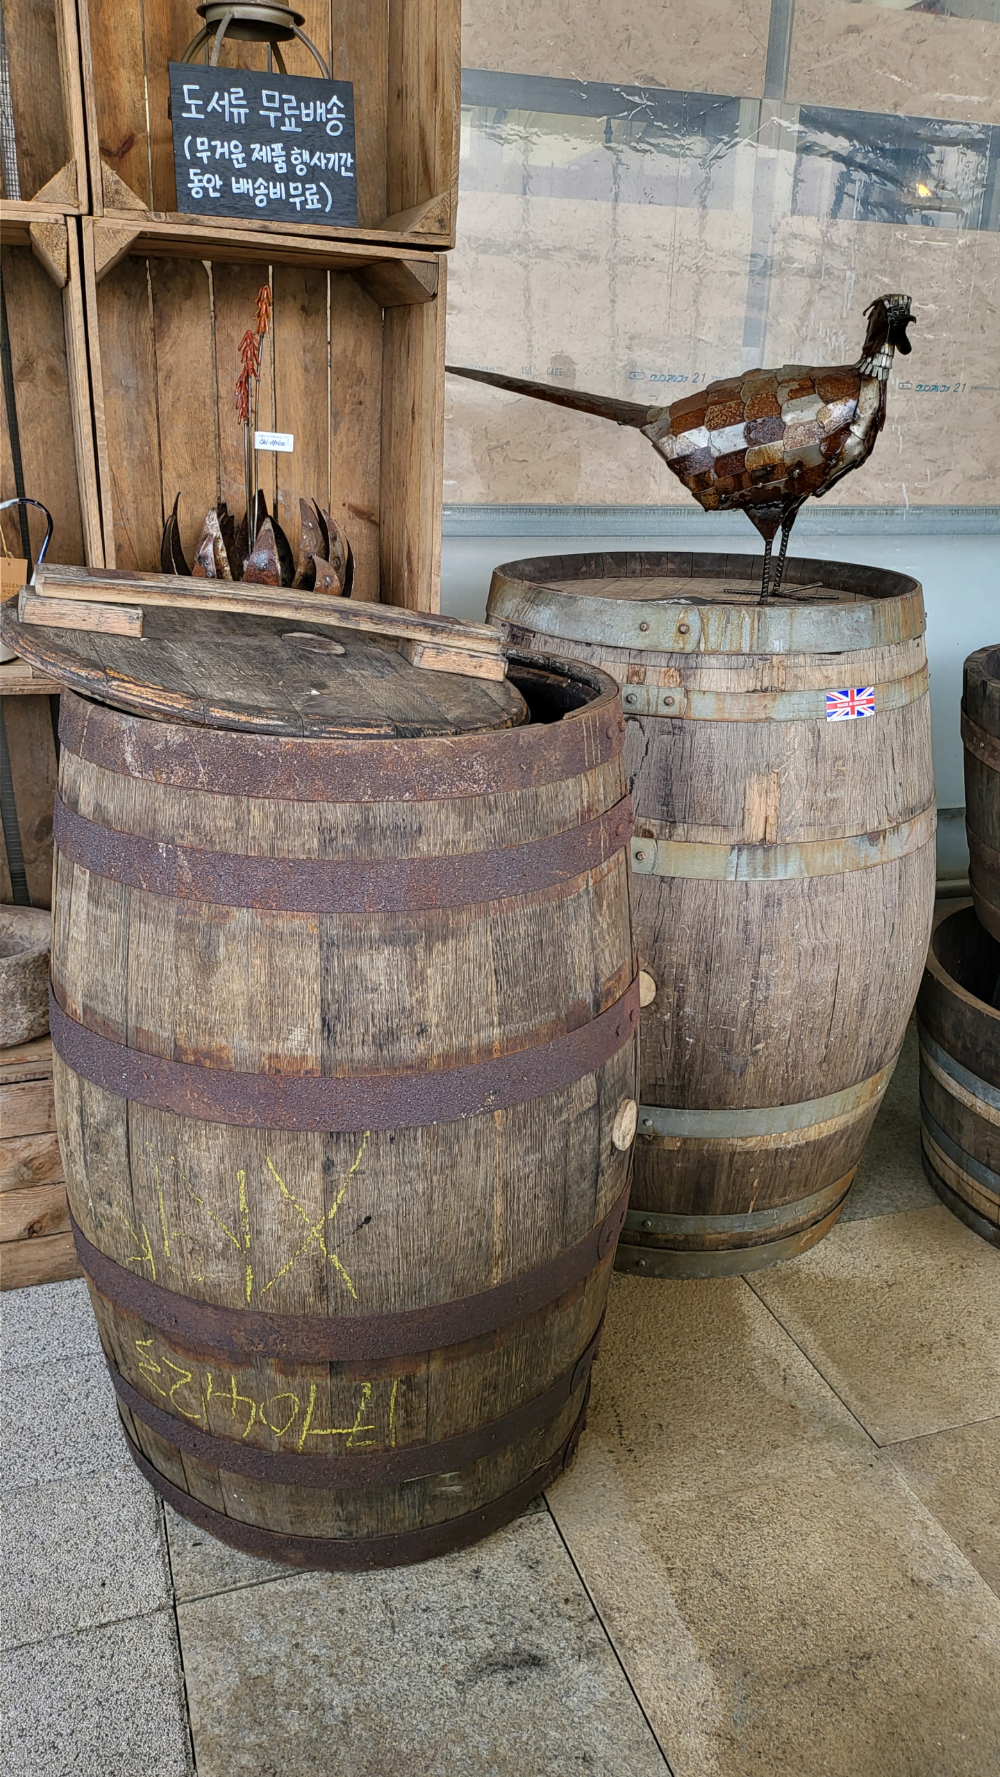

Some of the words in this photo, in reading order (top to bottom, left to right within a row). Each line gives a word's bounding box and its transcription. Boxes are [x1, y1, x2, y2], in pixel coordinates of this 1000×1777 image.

[182, 84, 249, 124] 도서류
[259, 89, 346, 136] 무료배송
[184, 135, 247, 169] (무거운
[250, 143, 287, 174] 제품
[290, 146, 354, 177] 행사기간
[187, 168, 223, 198] 동안
[231, 176, 286, 207] 배송비
[289, 182, 333, 212] 무료)
[692, 372, 706, 383] 21
[953, 382, 967, 393] 21
